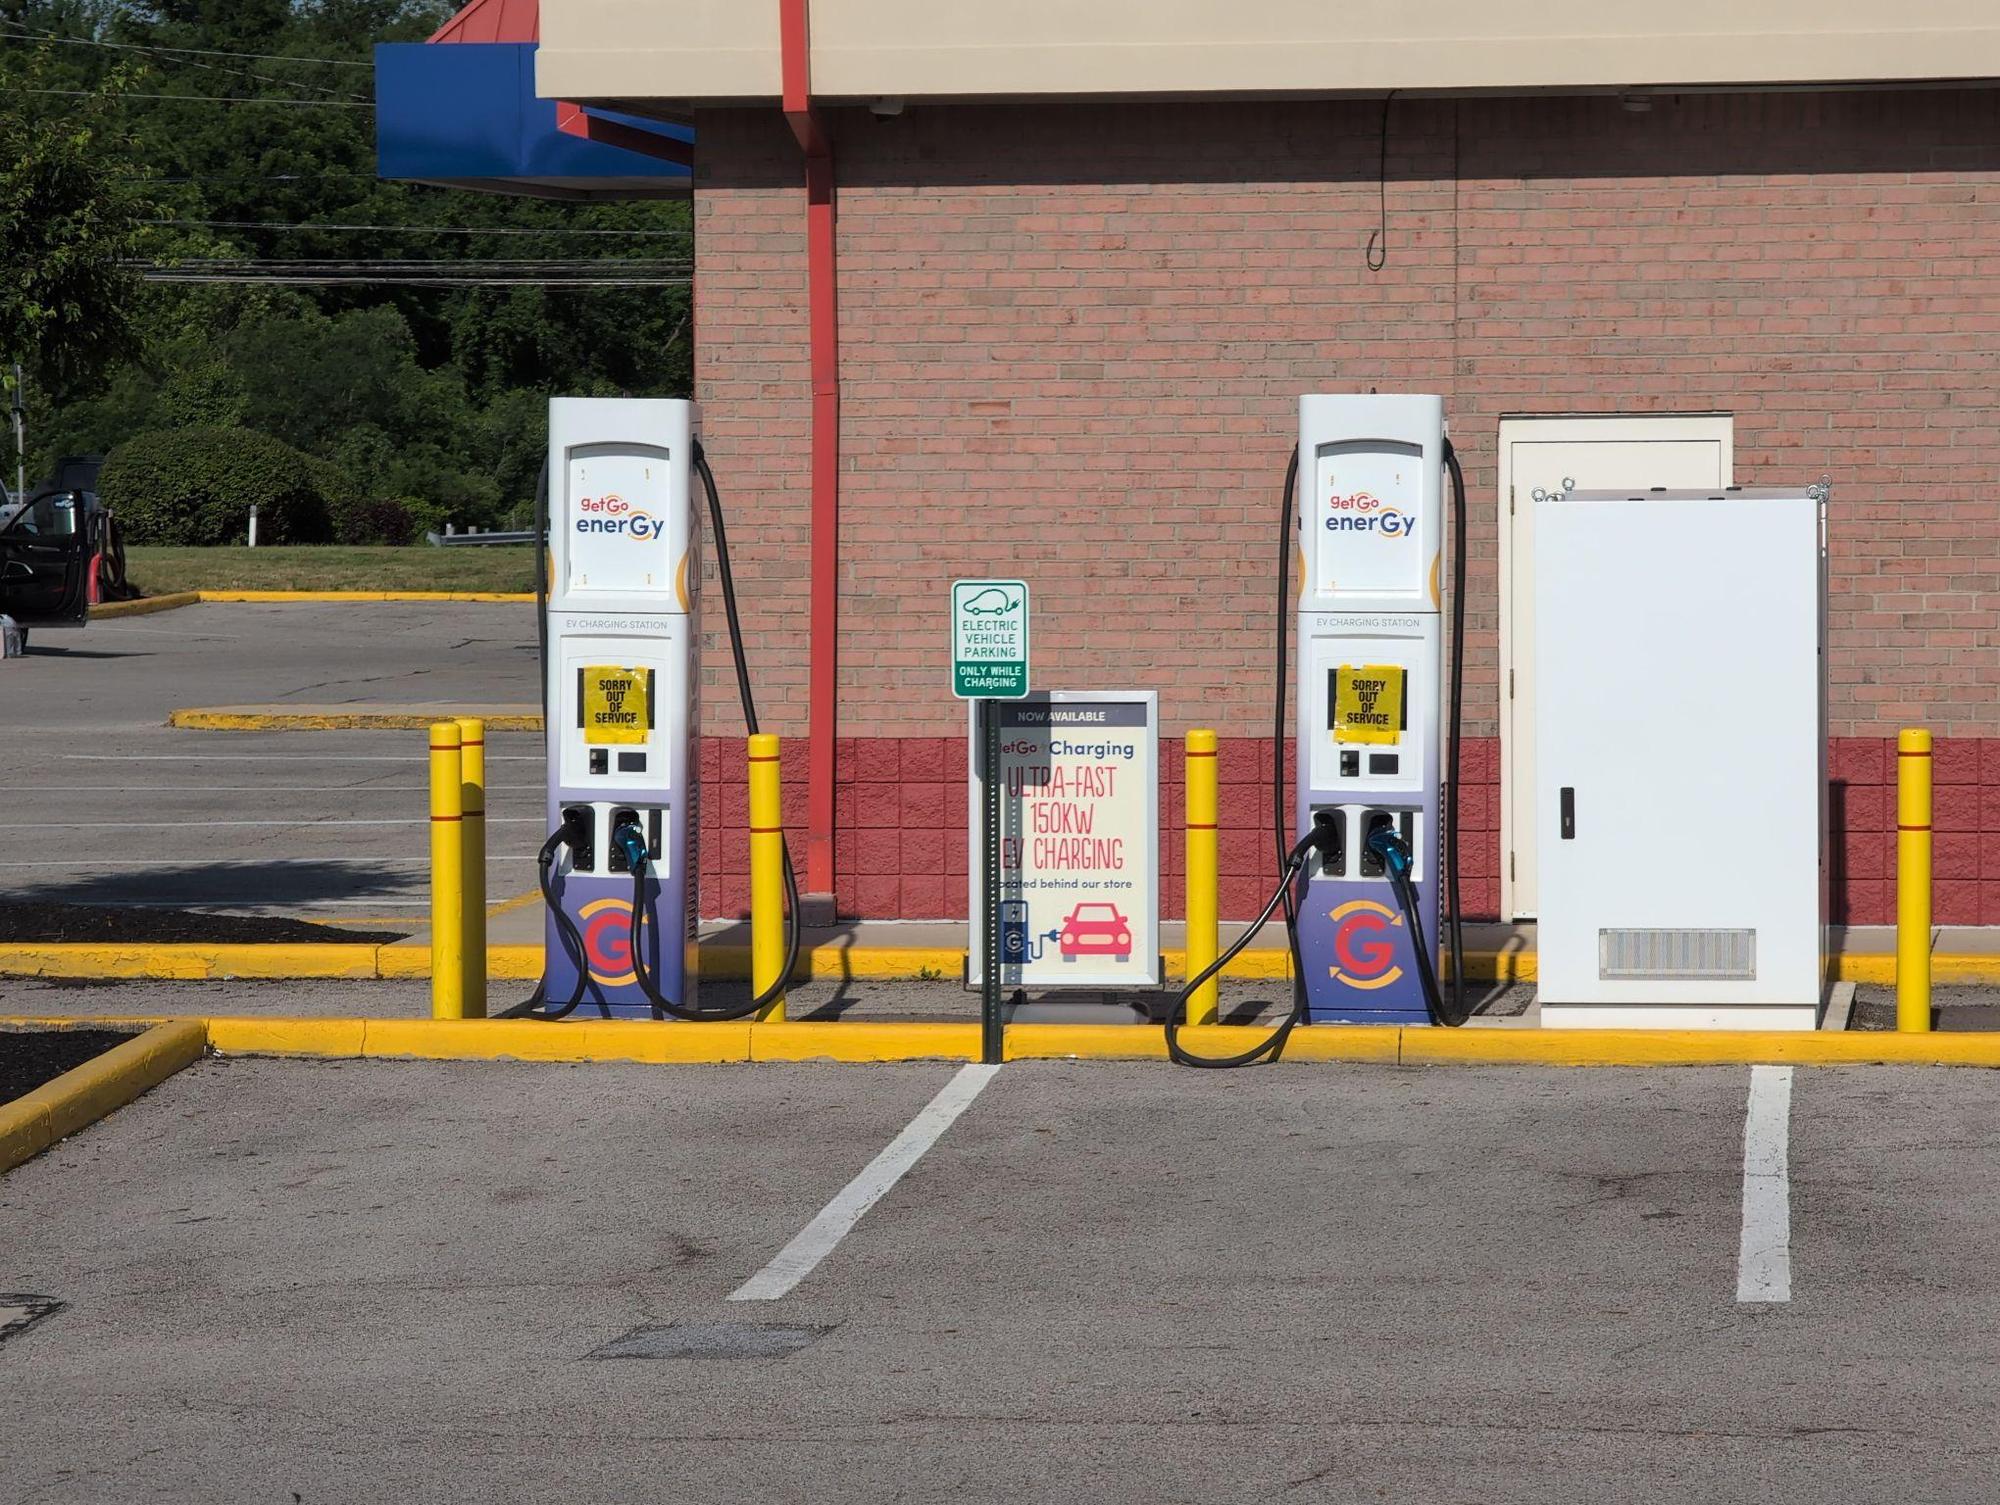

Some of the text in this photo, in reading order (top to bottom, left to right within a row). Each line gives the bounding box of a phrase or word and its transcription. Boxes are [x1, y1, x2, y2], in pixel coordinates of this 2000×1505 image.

[581, 497, 629, 513] getGo
[1330, 495, 1379, 510] getGo
[576, 515, 664, 539] enerGy
[1325, 512, 1416, 536] enerGy
[566, 619, 668, 629] EV CHARGING STATION
[962, 620, 1018, 631] ELECTRIC
[1316, 618, 1420, 627] EV CHARGING STATION
[965, 633, 1016, 644] VEHICLE
[964, 647, 1017, 658] PARKING
[960, 666, 1022, 676] ONLY WHILE
[599, 679, 632, 691] SORRY
[964, 677, 1017, 687] CHARGING
[1352, 679, 1386, 691] SORRY
[606, 691, 625, 702] OUT
[1358, 691, 1378, 702] OUT
[609, 702, 622, 713] OF
[1361, 702, 1375, 713] OF
[595, 712, 637, 723] SERVICE
[1017, 711, 1106, 722] NOW AVAILABLE
[1346, 712, 1389, 725] SERVICE
[999, 740, 1134, 760] etGo Charging
[1007, 766, 1118, 798] ULTRA-FAST
[1030, 801, 1094, 834] 150KW
[1002, 837, 1123, 870] EV CHARGING
[997, 878, 1133, 889] ocated behind our store
[1335, 914, 1394, 975] G
